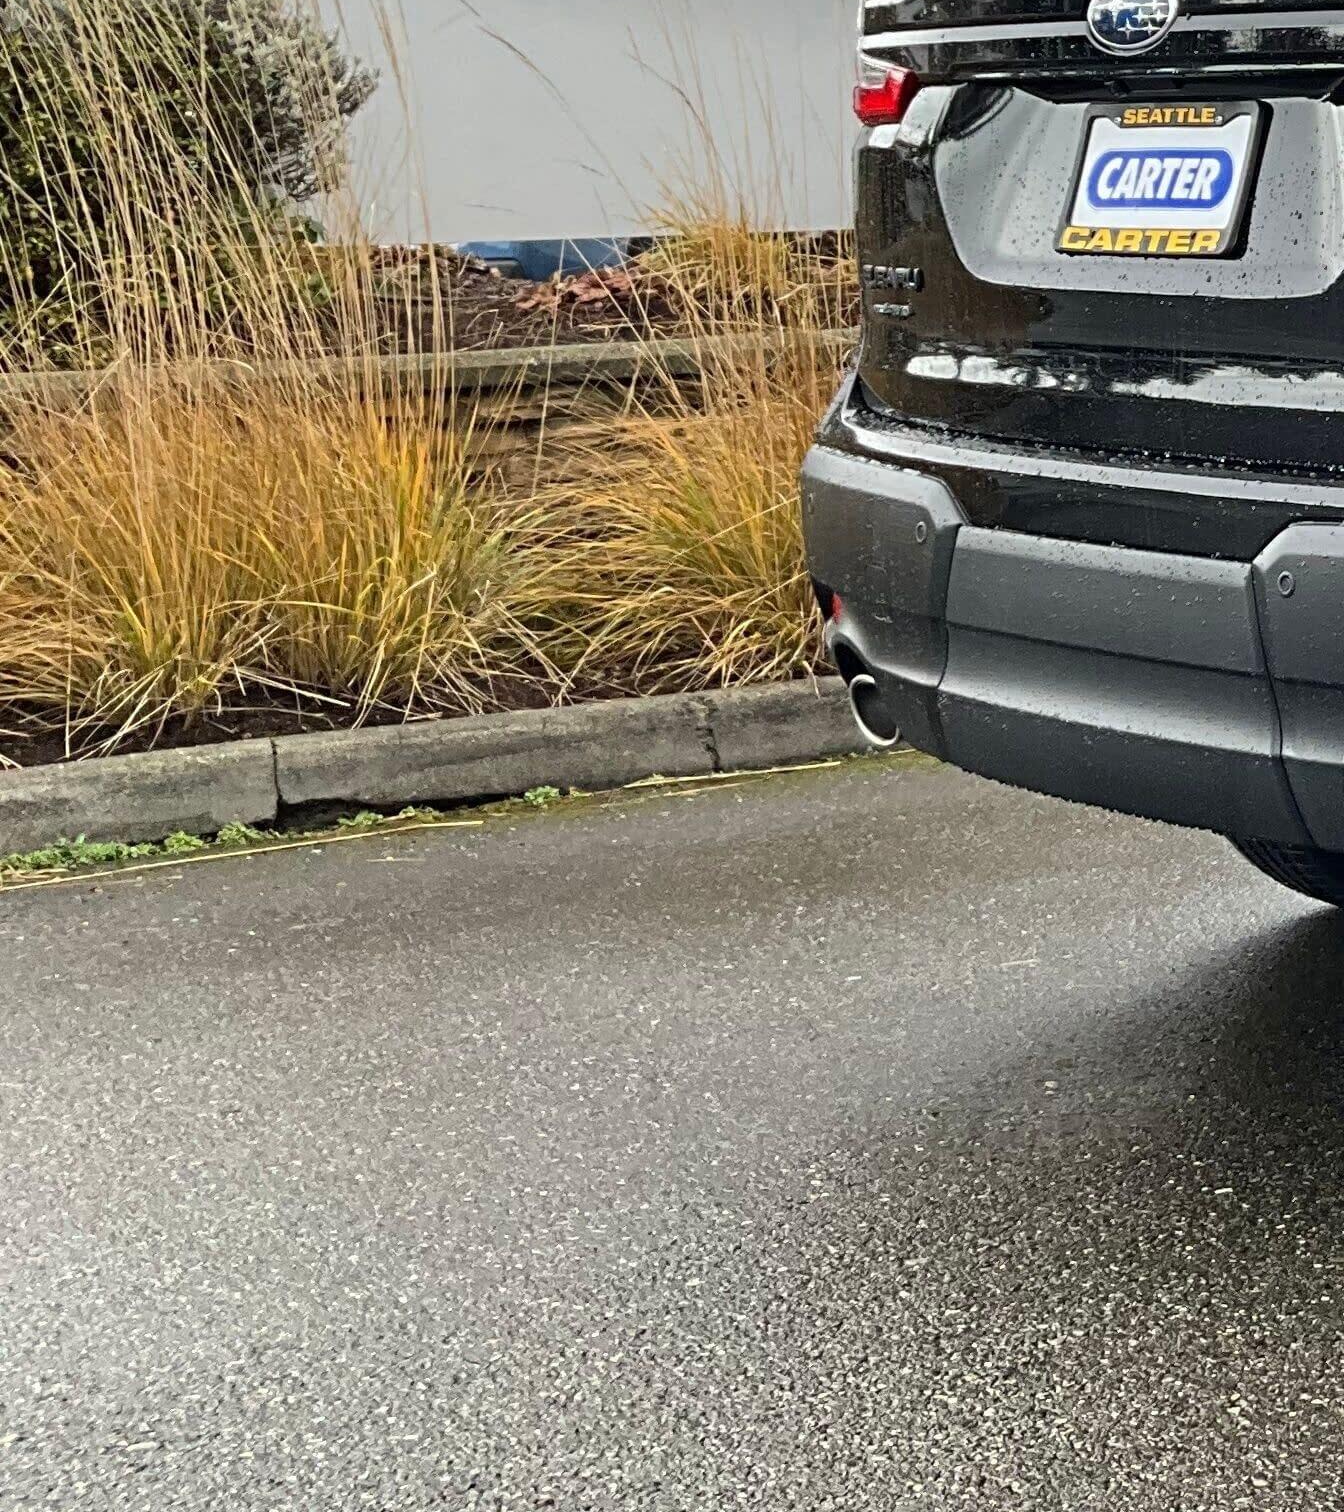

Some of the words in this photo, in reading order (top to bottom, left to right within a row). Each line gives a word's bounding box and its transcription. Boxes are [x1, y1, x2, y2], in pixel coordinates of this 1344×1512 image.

[1123, 107, 1216, 125] SEATTLE
[1097, 157, 1221, 200] CARTER
[1059, 226, 1221, 253] CARTER
